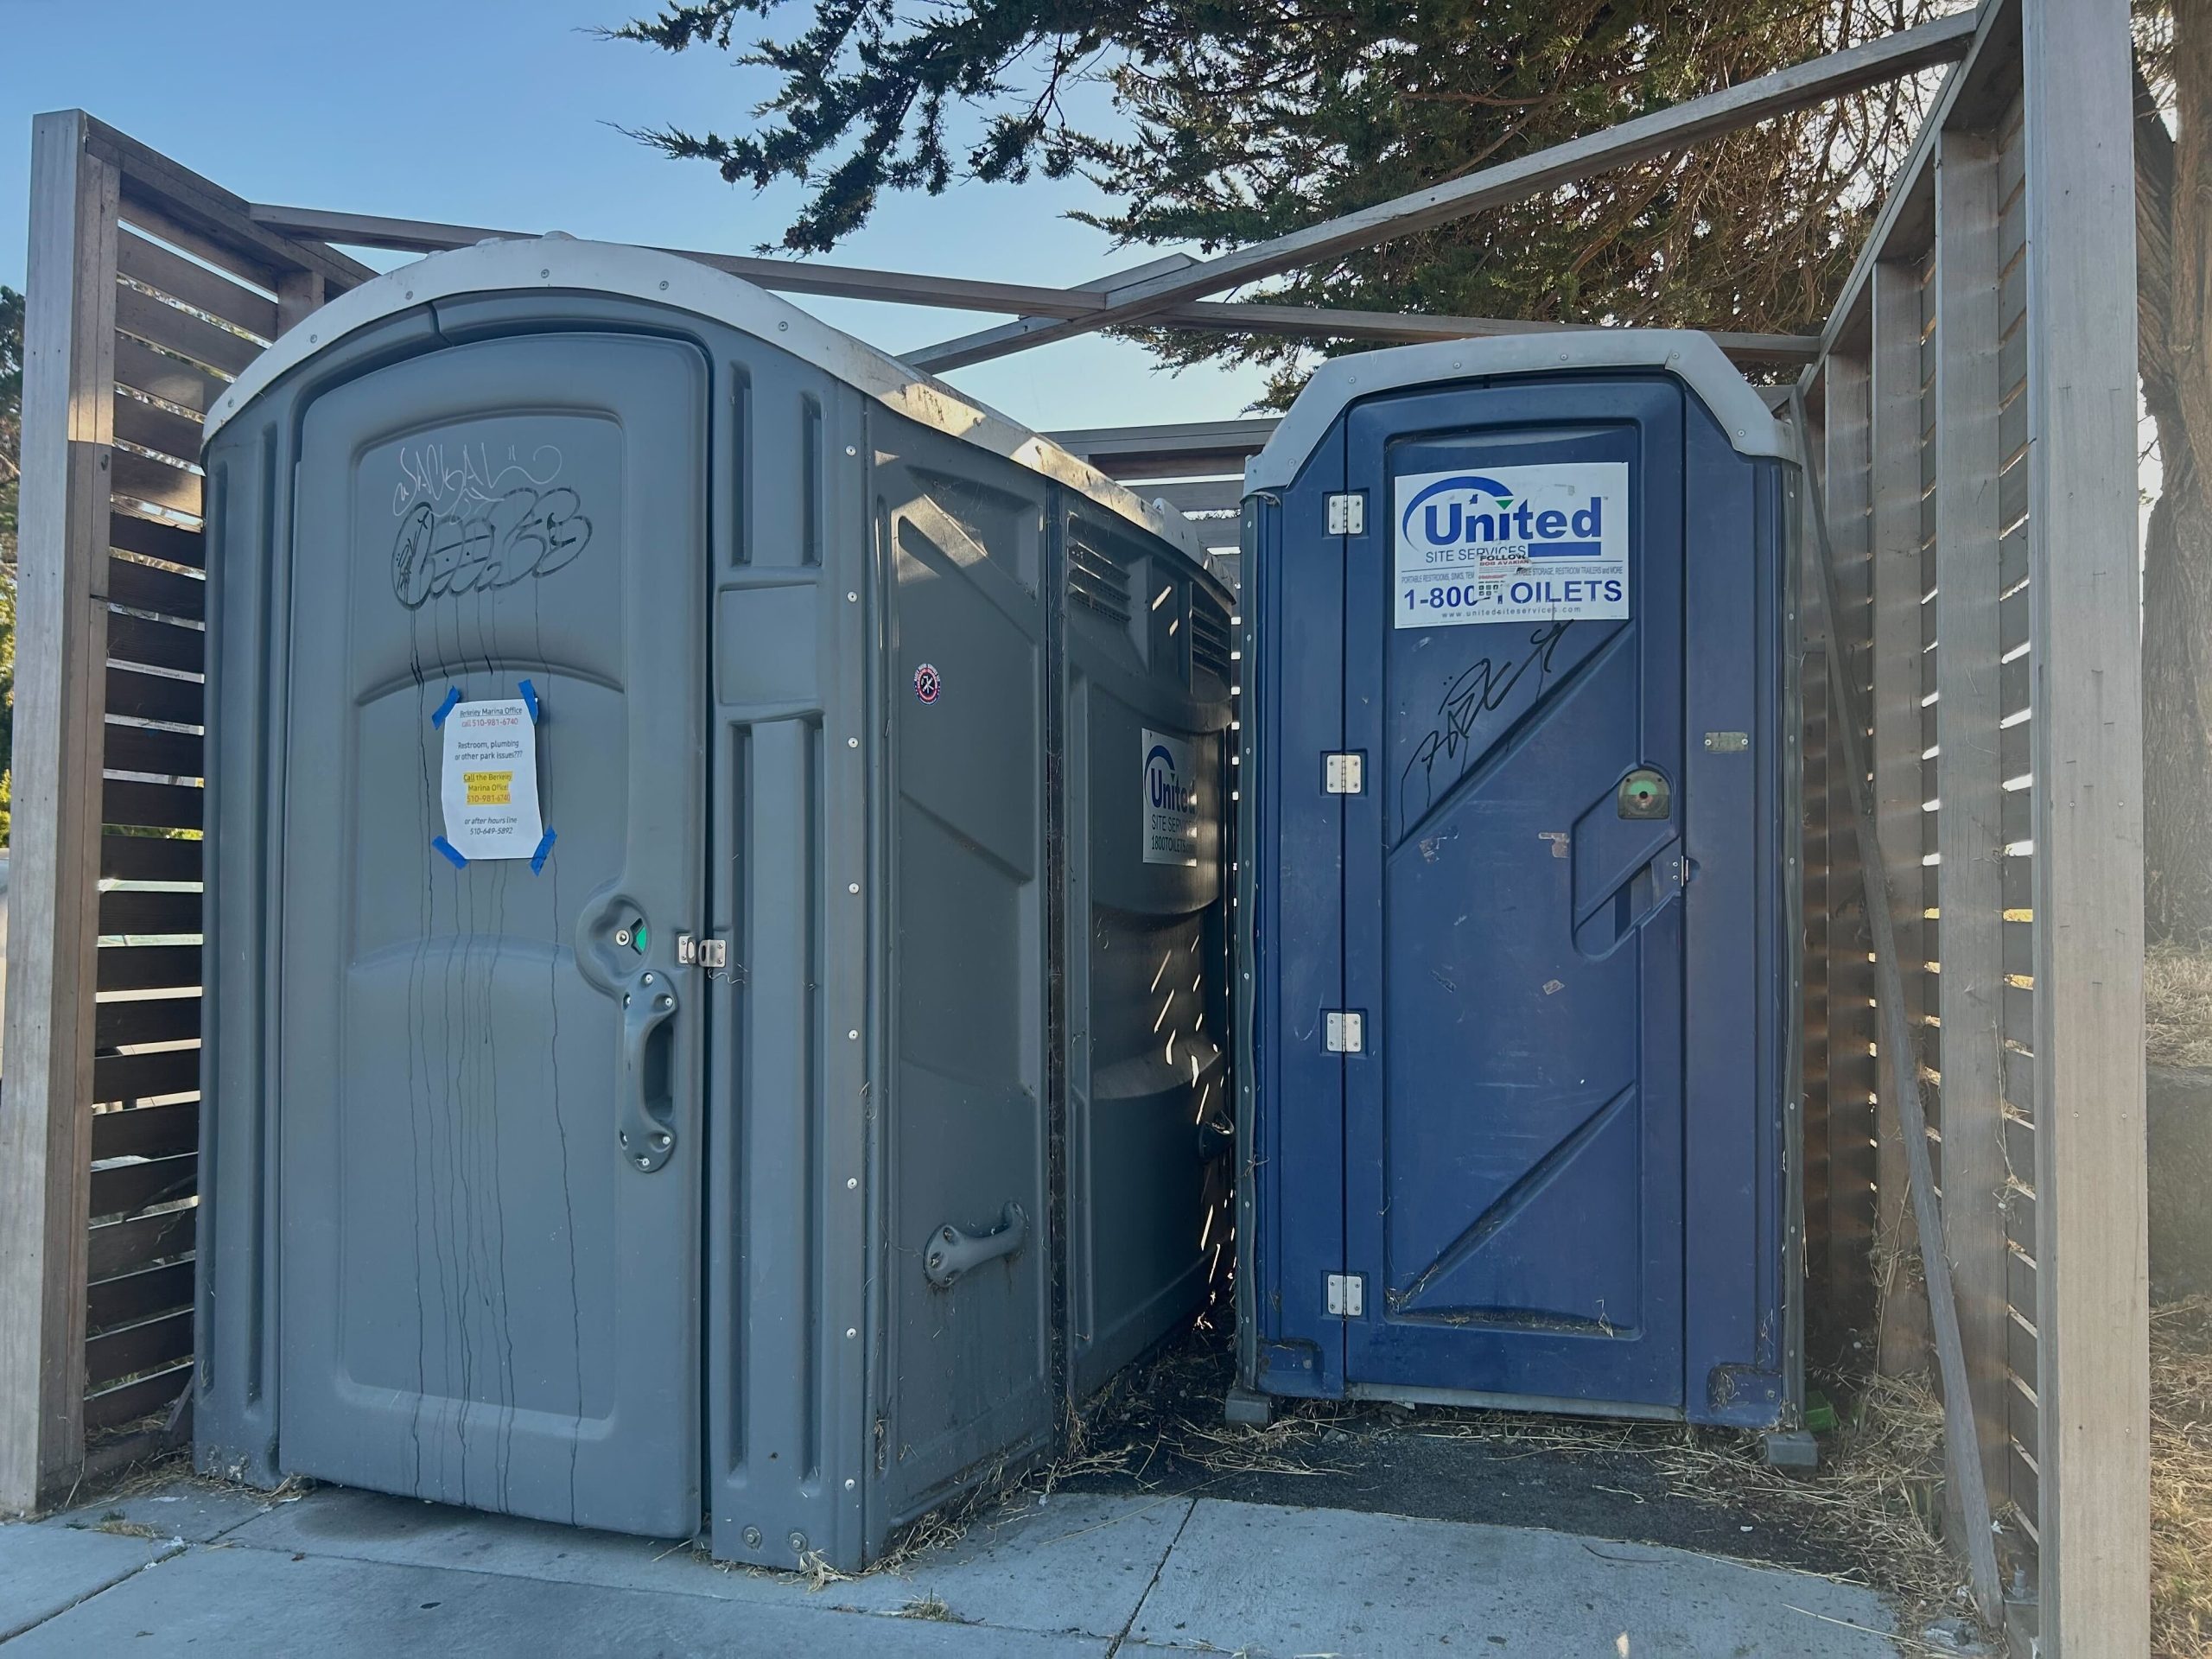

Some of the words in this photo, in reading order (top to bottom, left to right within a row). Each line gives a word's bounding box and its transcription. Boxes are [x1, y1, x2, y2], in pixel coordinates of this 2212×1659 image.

[1425, 495, 1601, 545] United
[1426, 550, 1454, 563] SITE
[1458, 545, 1526, 561] SERVICES
[1442, 606, 1581, 618] www.unitedsiteservices.com
[472, 718, 518, 727] 510-981-6740
[490, 741, 519, 749] plumbing
[480, 751, 495, 760] park
[463, 773, 474, 782] Call
[1151, 768, 1196, 814] United
[1152, 814, 1166, 831] SITE
[1168, 817, 1196, 835] SERVIC
[470, 827, 513, 836] 510-649-5892
